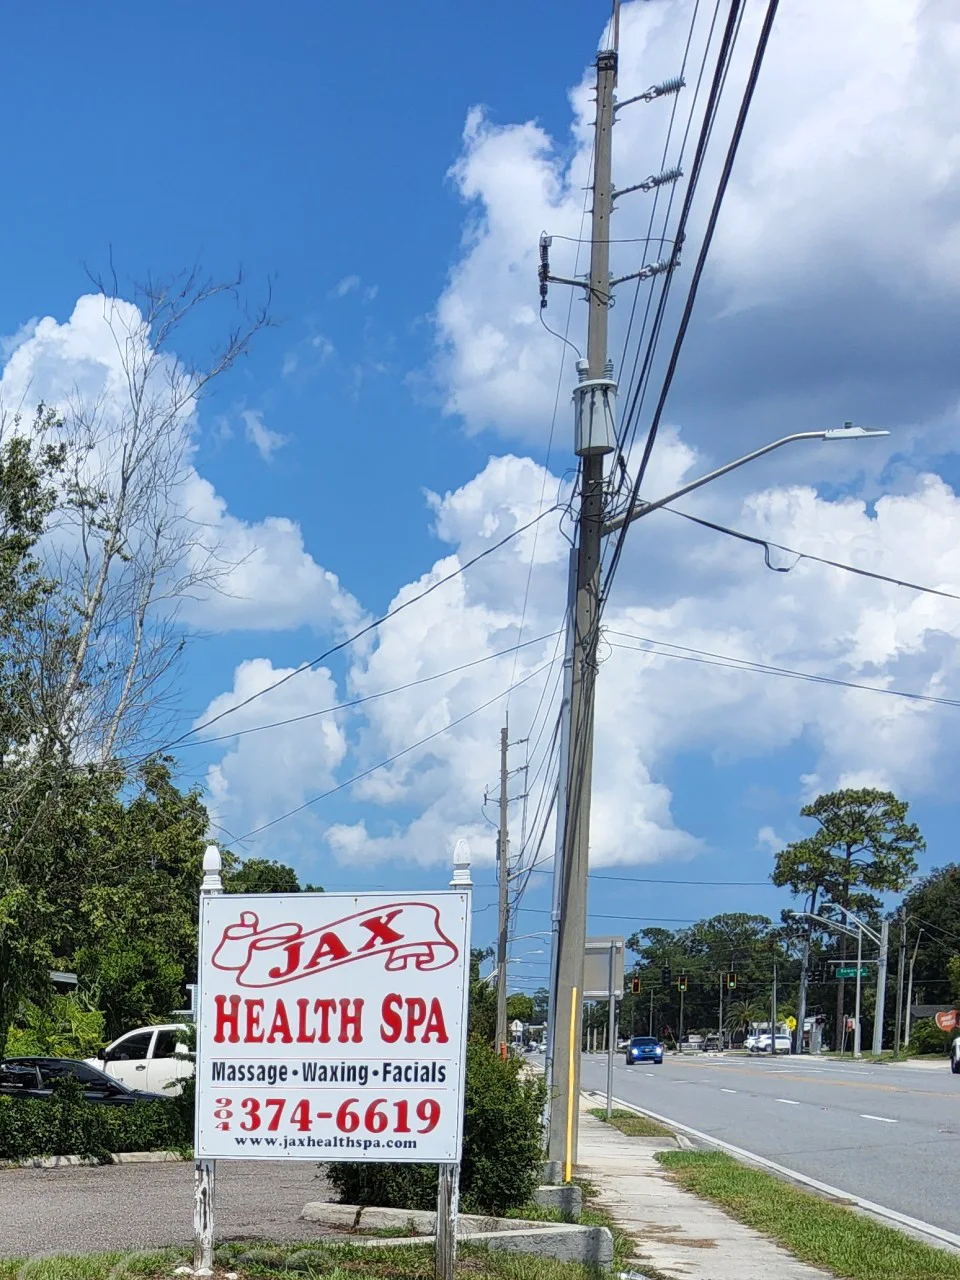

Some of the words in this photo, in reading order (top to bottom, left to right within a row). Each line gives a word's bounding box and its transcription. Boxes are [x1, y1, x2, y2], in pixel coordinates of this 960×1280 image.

[268, 909, 405, 978] JAX
[213, 994, 364, 1044] HEALTH
[380, 992, 449, 1044] SPA
[239, 1097, 441, 1134] 374-6619
[234, 1136, 417, 1151] www.jaxhealthspa.com
